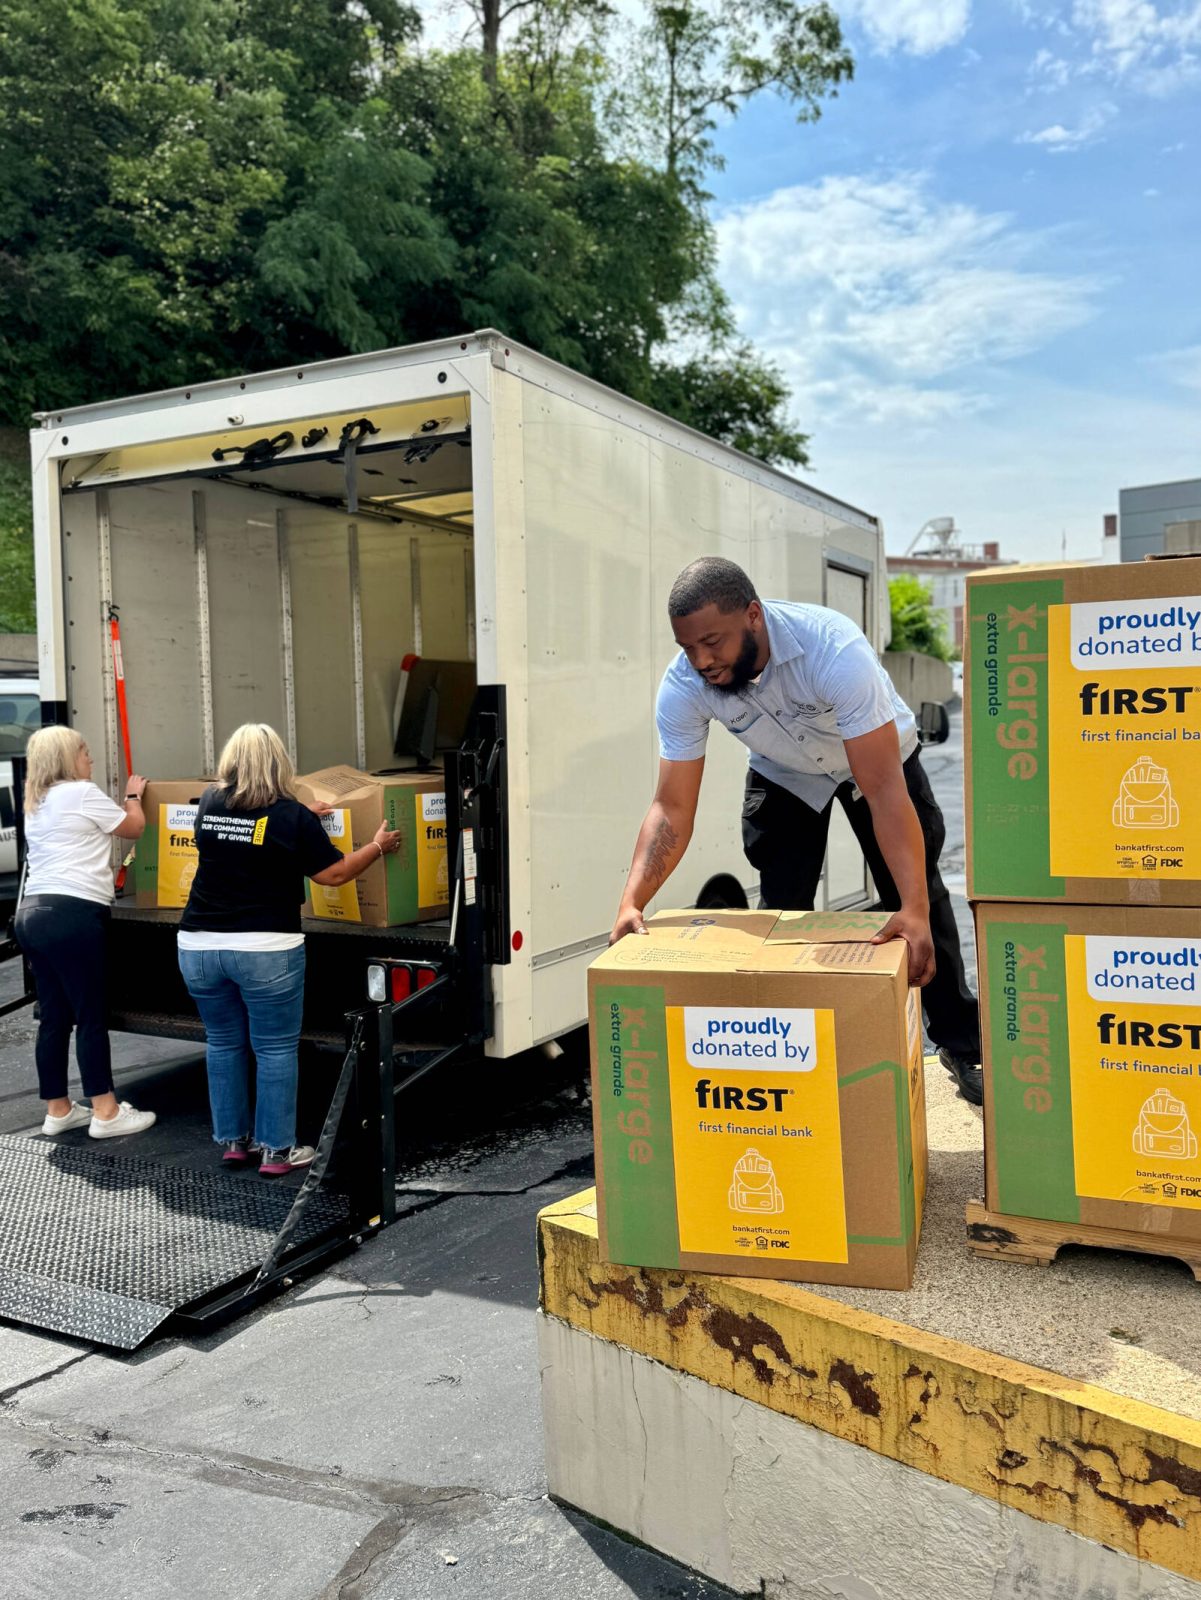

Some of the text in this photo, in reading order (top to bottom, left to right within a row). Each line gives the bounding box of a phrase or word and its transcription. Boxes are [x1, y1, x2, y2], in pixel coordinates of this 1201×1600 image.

[1098, 606, 1201, 634] proudly
[1078, 632, 1182, 657] donated
[985, 612, 1002, 716] extra grande
[996, 603, 1048, 780] x-large
[1081, 729, 1111, 742] first
[1115, 727, 1177, 742] financial
[203, 815, 256, 826] STRENGTHENING
[213, 824, 255, 834] COMMUNITY
[228, 834, 252, 842] GIVING
[254, 821, 265, 844] MORE
[1115, 844, 1184, 852] bankatfirst.com
[1160, 858, 1183, 867] FDIC
[1113, 947, 1201, 968] proudl
[1094, 968, 1195, 991] donated
[1004, 941, 1020, 1042] extra grande
[707, 1016, 792, 1039] proudly
[1010, 944, 1059, 1113] x-large
[609, 1002, 625, 1097] extra grande
[692, 1037, 810, 1062] donated by
[1100, 1057, 1193, 1076] first financial
[617, 1004, 658, 1165] x-large
[698, 1121, 813, 1137] first financial bank
[732, 1224, 790, 1235] bankatfirst.com
[770, 1240, 790, 1248] FDIC
